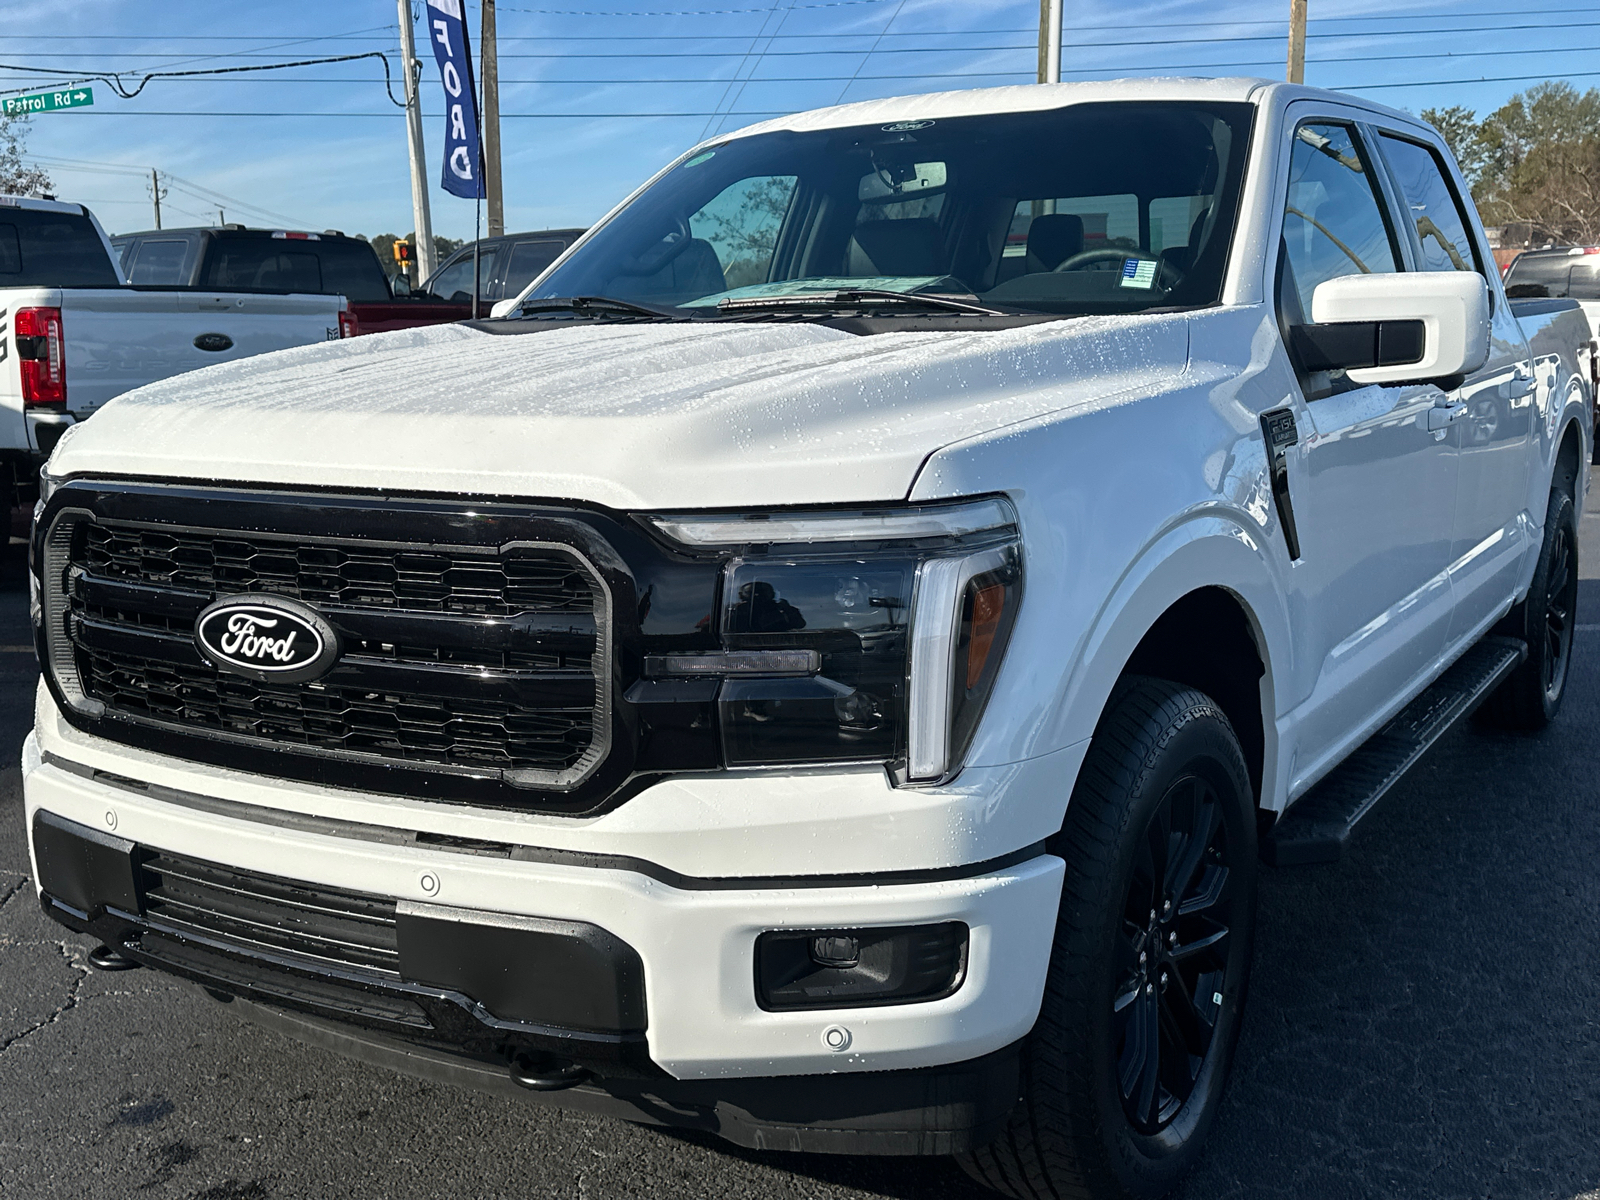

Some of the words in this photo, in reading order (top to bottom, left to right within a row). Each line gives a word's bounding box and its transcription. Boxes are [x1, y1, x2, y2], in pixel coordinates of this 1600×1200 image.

[6, 95, 46, 113] Patrol
[53, 92, 71, 107] Rd
[220, 613, 297, 662] Ford
